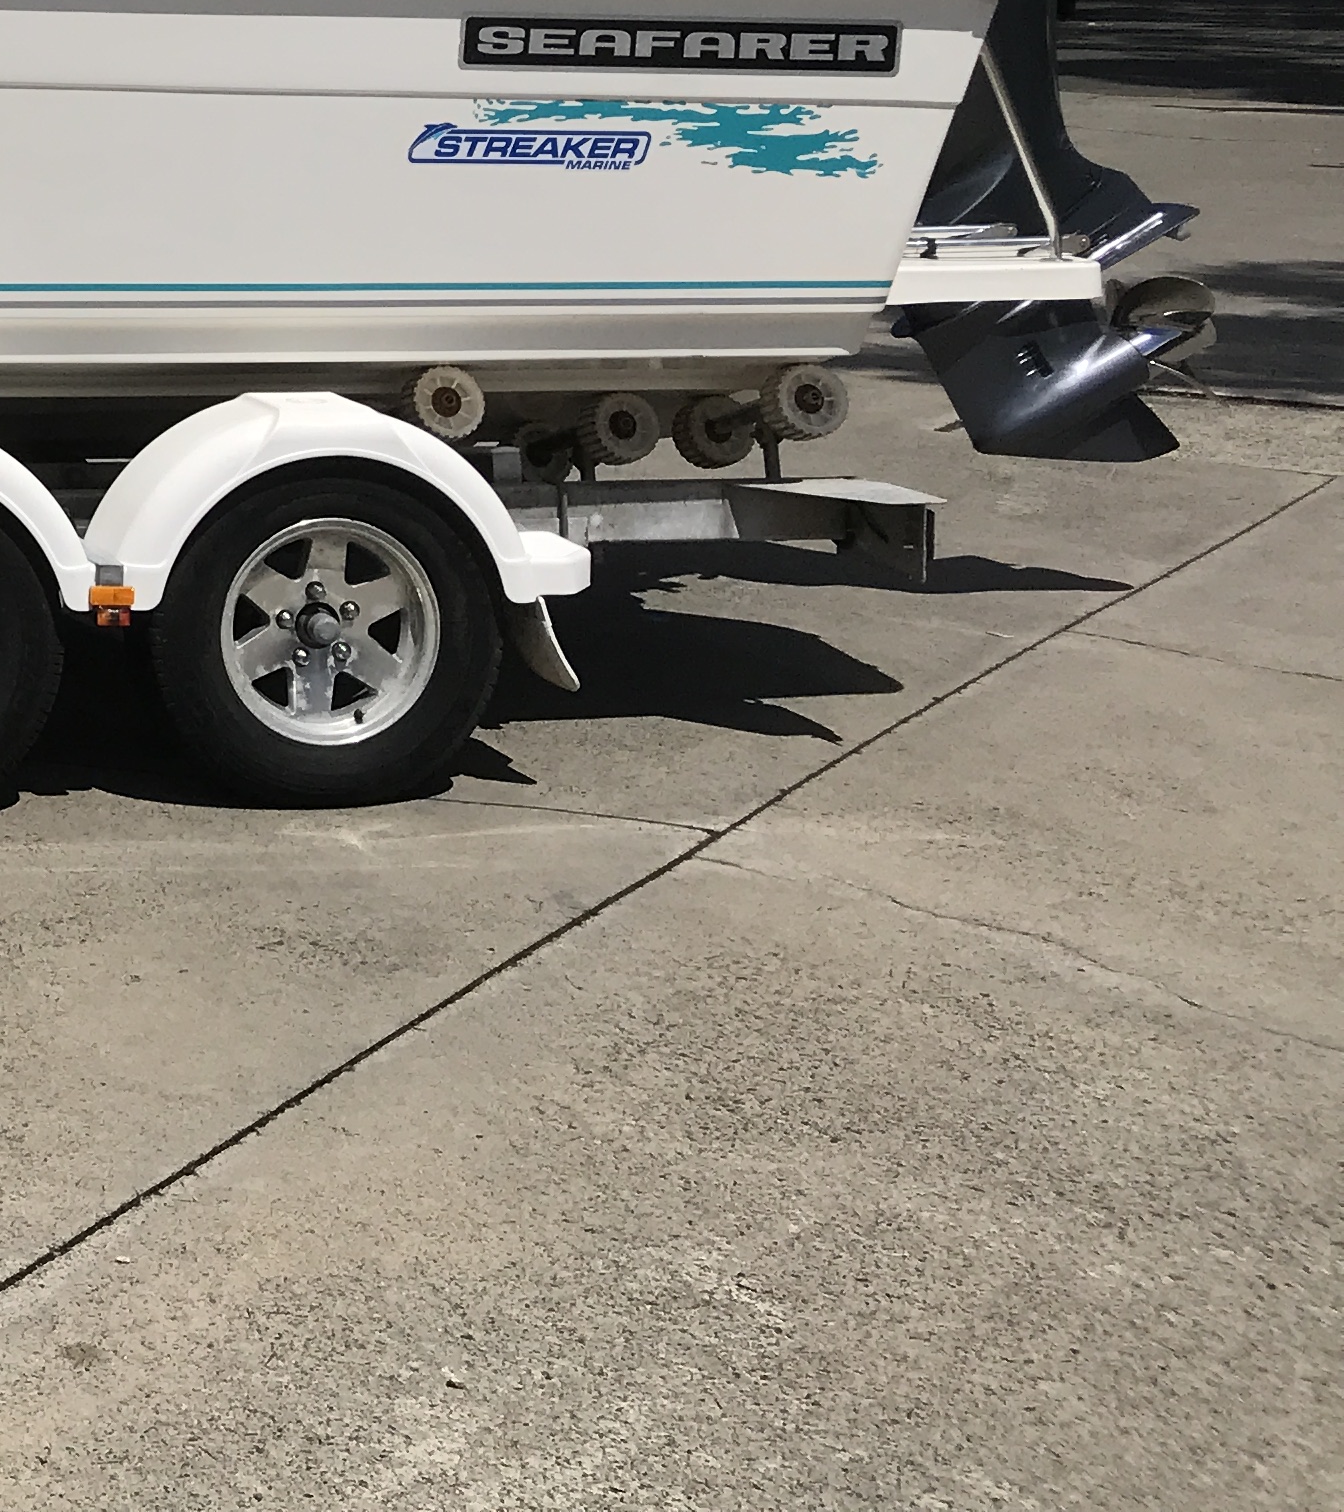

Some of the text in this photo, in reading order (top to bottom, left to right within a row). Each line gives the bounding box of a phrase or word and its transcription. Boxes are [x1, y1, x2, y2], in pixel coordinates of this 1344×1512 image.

[476, 26, 889, 62] SEAFARER
[433, 134, 641, 159] STREAKER
[565, 160, 632, 170] MARINE
